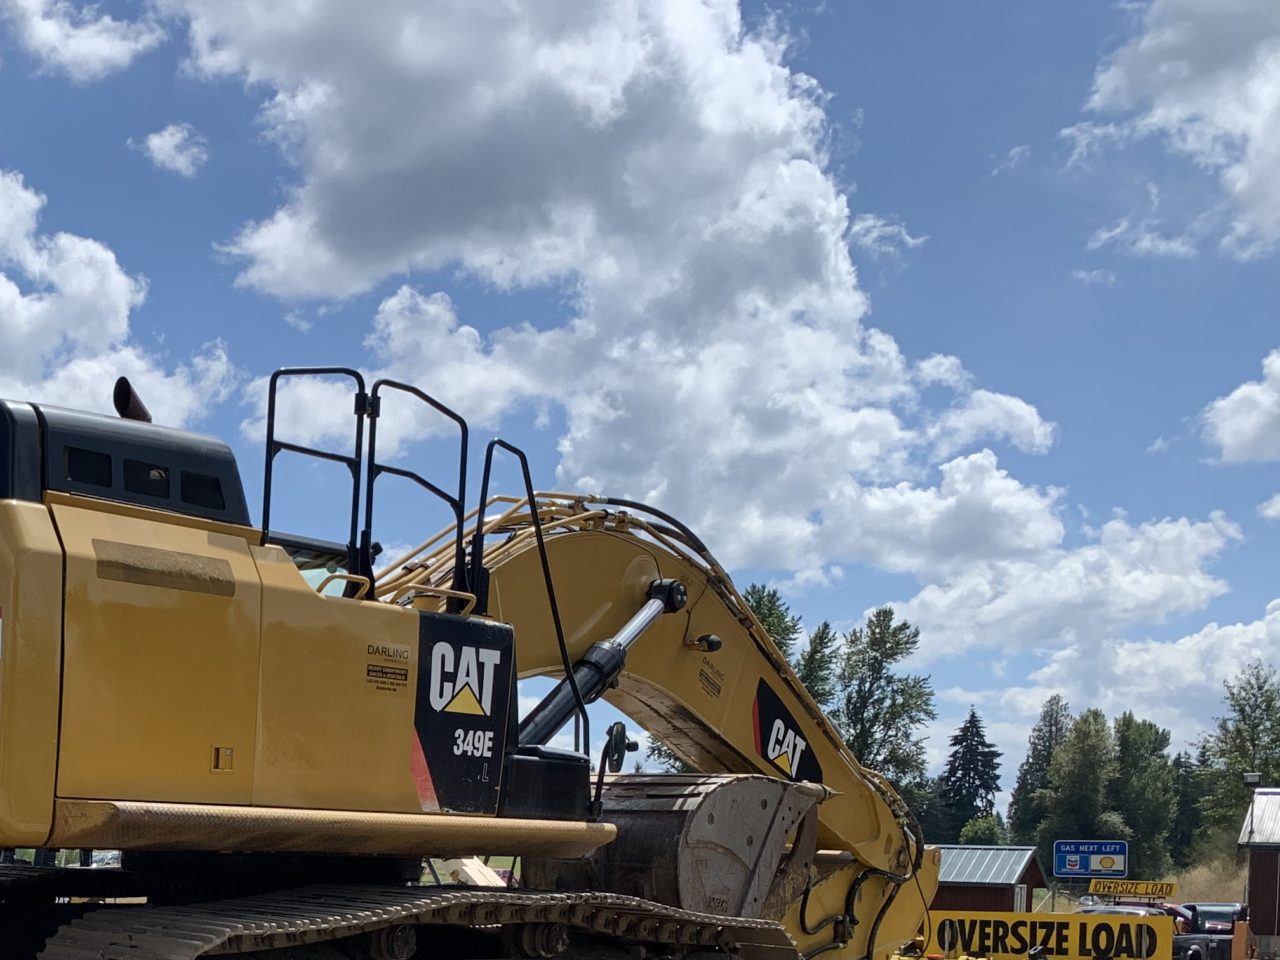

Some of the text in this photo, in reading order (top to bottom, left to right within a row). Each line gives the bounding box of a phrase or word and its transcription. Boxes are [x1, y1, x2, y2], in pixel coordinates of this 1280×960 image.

[367, 645, 409, 659] DARLING
[429, 641, 501, 716] CAT
[453, 728, 494, 758] 349E
[767, 718, 806, 779] CAT
[1101, 844, 1121, 852] LEFT
[1094, 882, 1173, 896] OVERSIZE LOAD
[937, 918, 1158, 959] OVERSIZE LOAD
